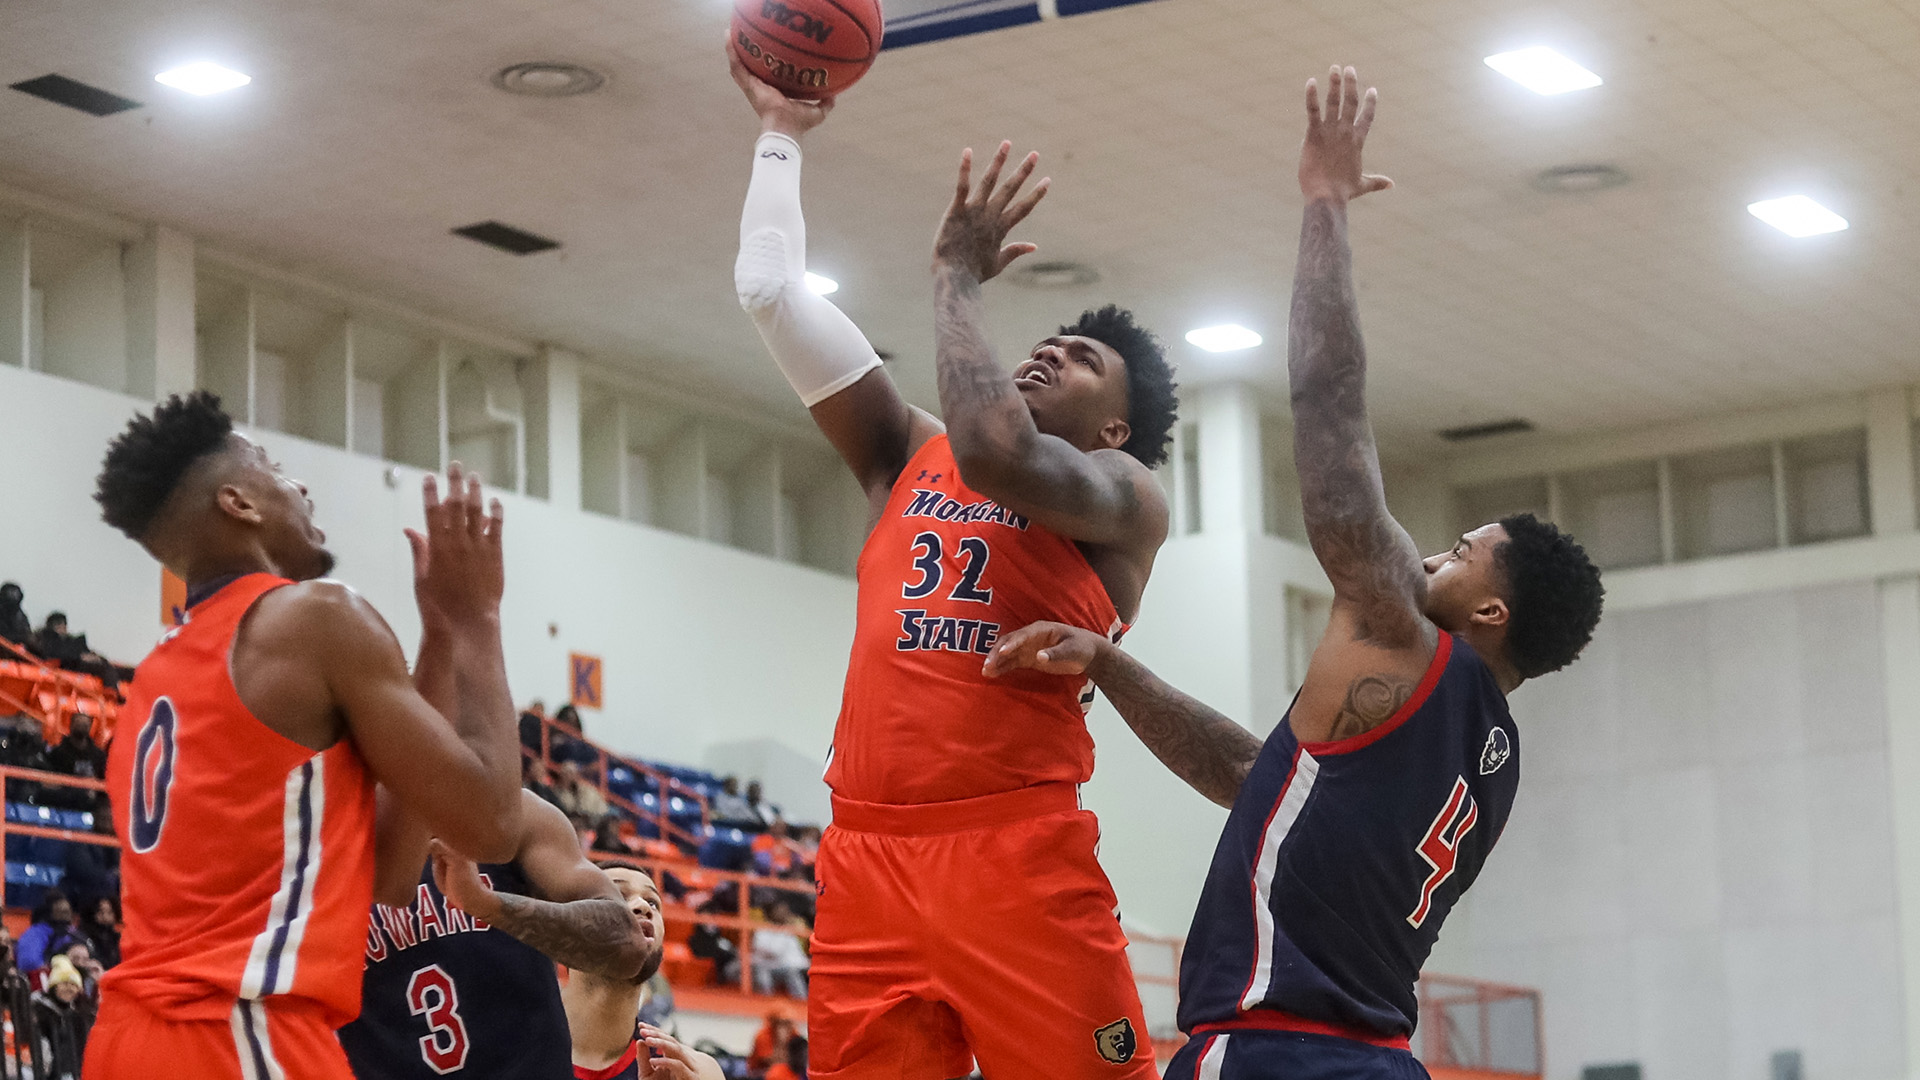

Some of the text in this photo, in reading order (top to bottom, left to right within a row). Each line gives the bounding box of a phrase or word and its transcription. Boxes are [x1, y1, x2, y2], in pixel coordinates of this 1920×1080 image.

[761, 1, 833, 44] NCAA
[738, 29, 829, 87] Wilson
[902, 488, 1031, 532] MORGAN
[902, 530, 993, 605] 32
[894, 609, 1000, 656] STATE
[574, 658, 596, 702] K
[129, 695, 178, 854] 0
[1406, 774, 1478, 930] 4
[406, 963, 470, 1075] 3
